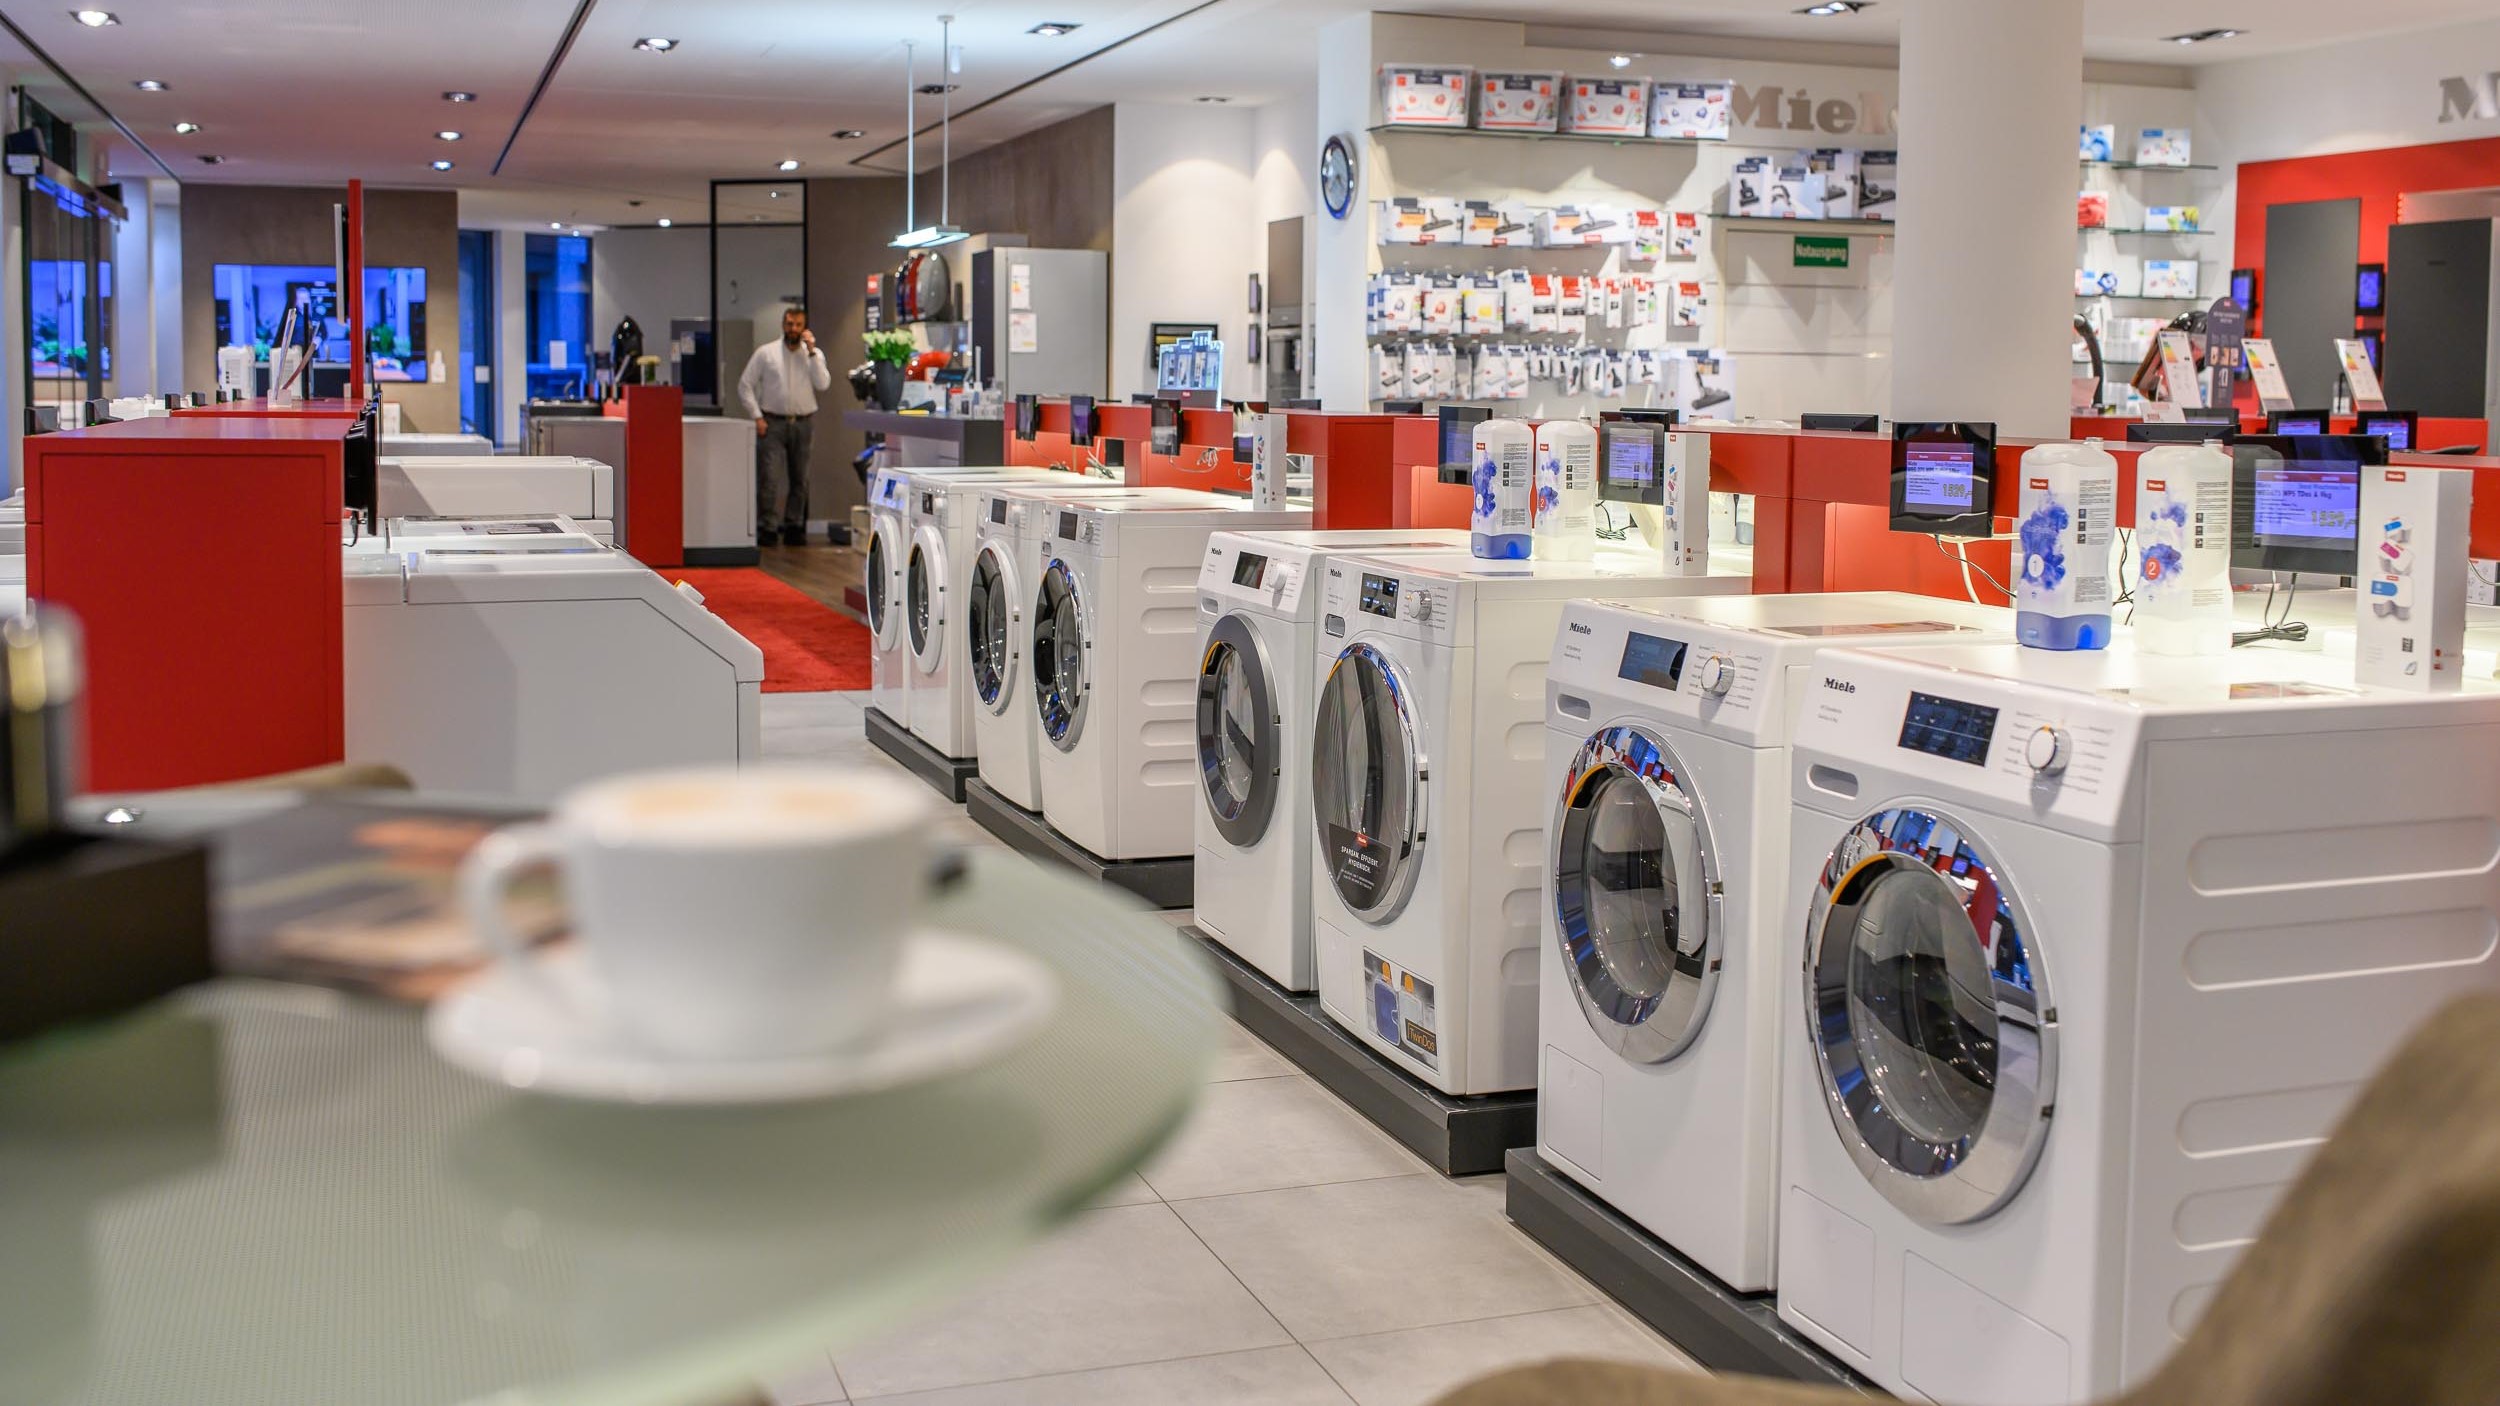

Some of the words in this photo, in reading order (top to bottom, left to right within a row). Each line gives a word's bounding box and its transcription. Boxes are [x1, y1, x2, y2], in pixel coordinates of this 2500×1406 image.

[1731, 84, 1897, 135] Miel
[1796, 243, 1847, 262] Notausgang
[2148, 561, 2157, 576] 2
[1568, 622, 1592, 635] Miele
[1824, 677, 1856, 694] Miele
